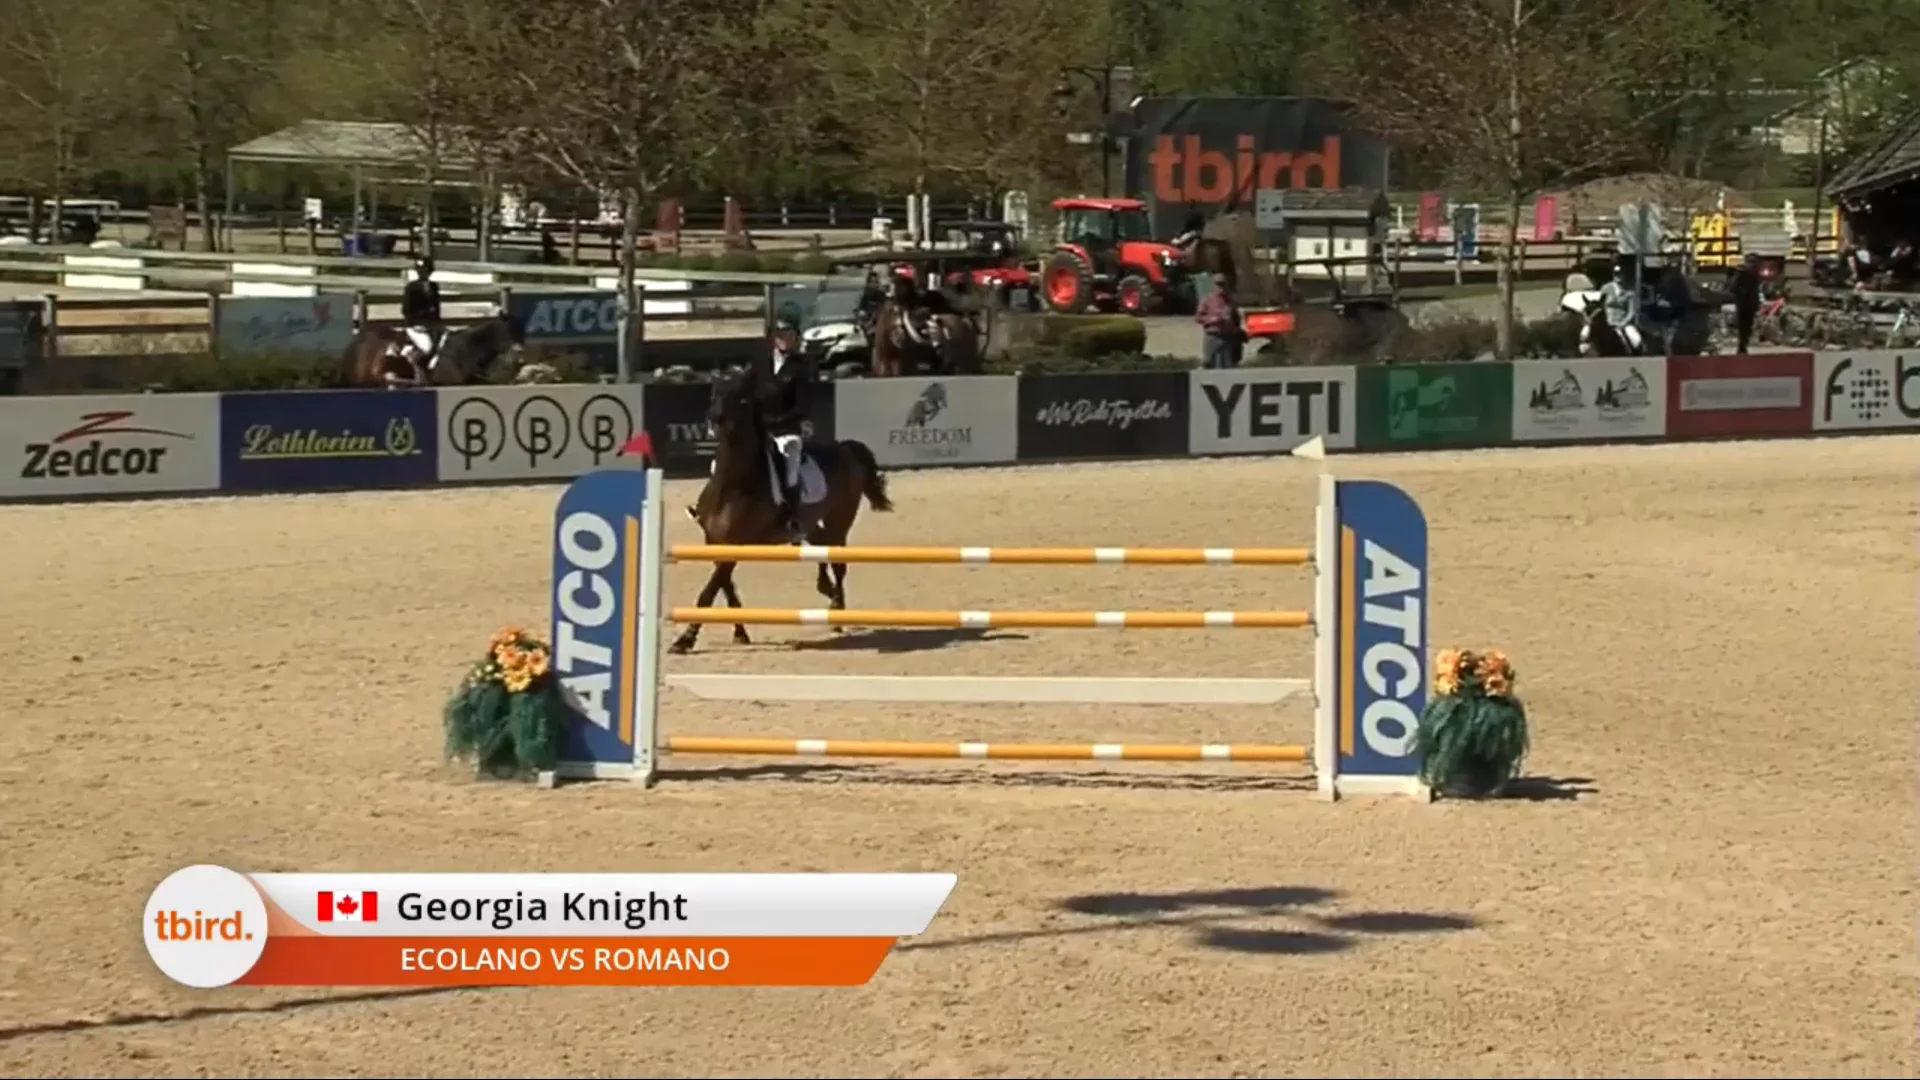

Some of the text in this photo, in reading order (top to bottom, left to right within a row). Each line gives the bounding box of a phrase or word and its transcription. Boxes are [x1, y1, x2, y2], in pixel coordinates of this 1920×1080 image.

[1148, 134, 1341, 203] tbird
[526, 298, 619, 333] ATCO
[1202, 381, 1340, 438] YETI
[20, 440, 166, 479] Zedcor
[242, 424, 375, 454] Lothlorien
[888, 427, 972, 445] FREEDOM
[556, 511, 617, 731] ATCO
[1361, 538, 1420, 758] ATCO
